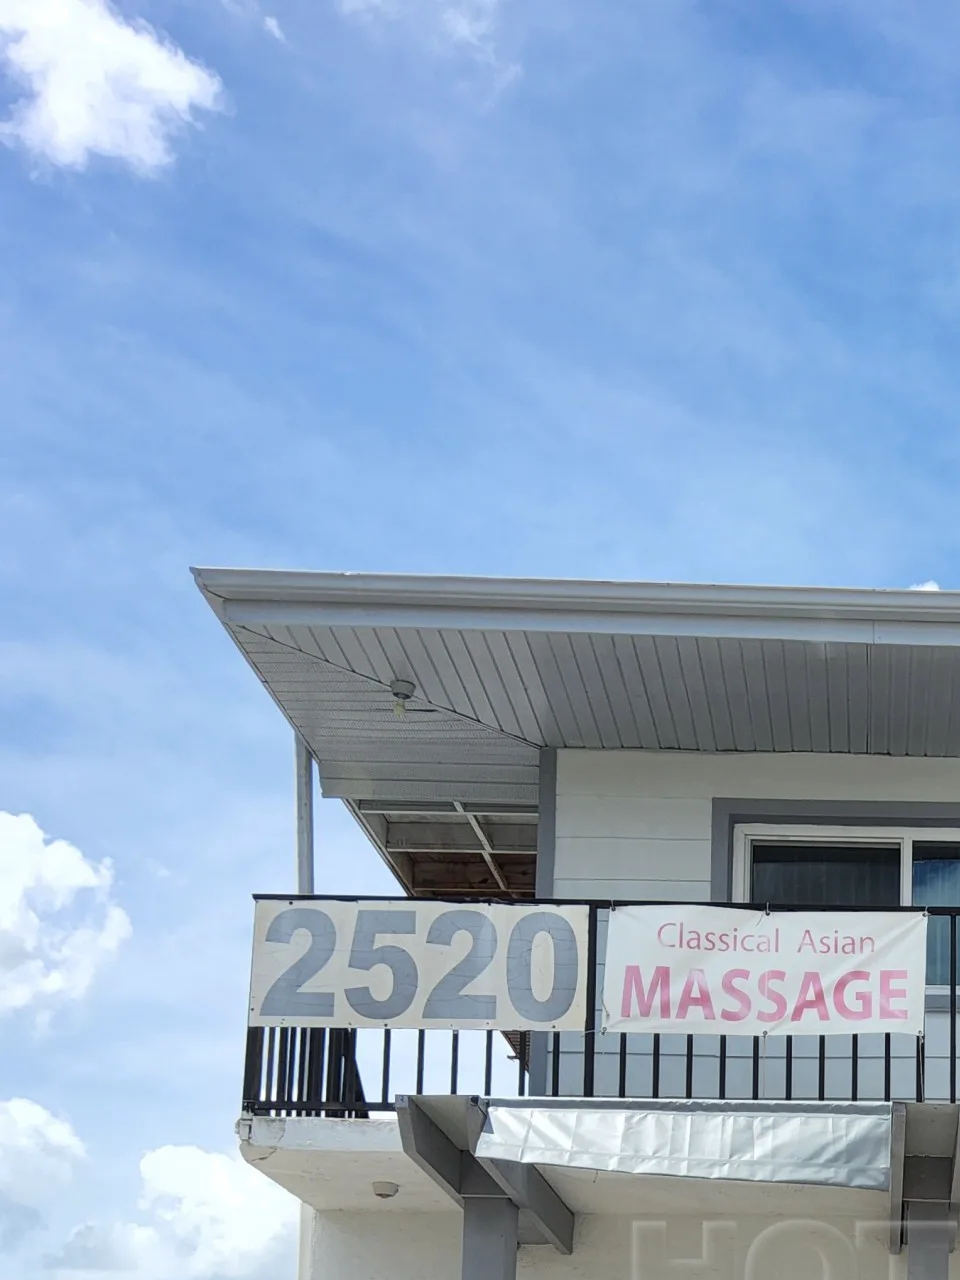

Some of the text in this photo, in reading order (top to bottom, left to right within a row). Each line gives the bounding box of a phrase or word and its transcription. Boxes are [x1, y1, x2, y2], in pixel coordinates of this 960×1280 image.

[259, 908, 579, 1023] 2520
[657, 922, 877, 956] Classical Asian
[620, 965, 910, 1023] MASSAGE
